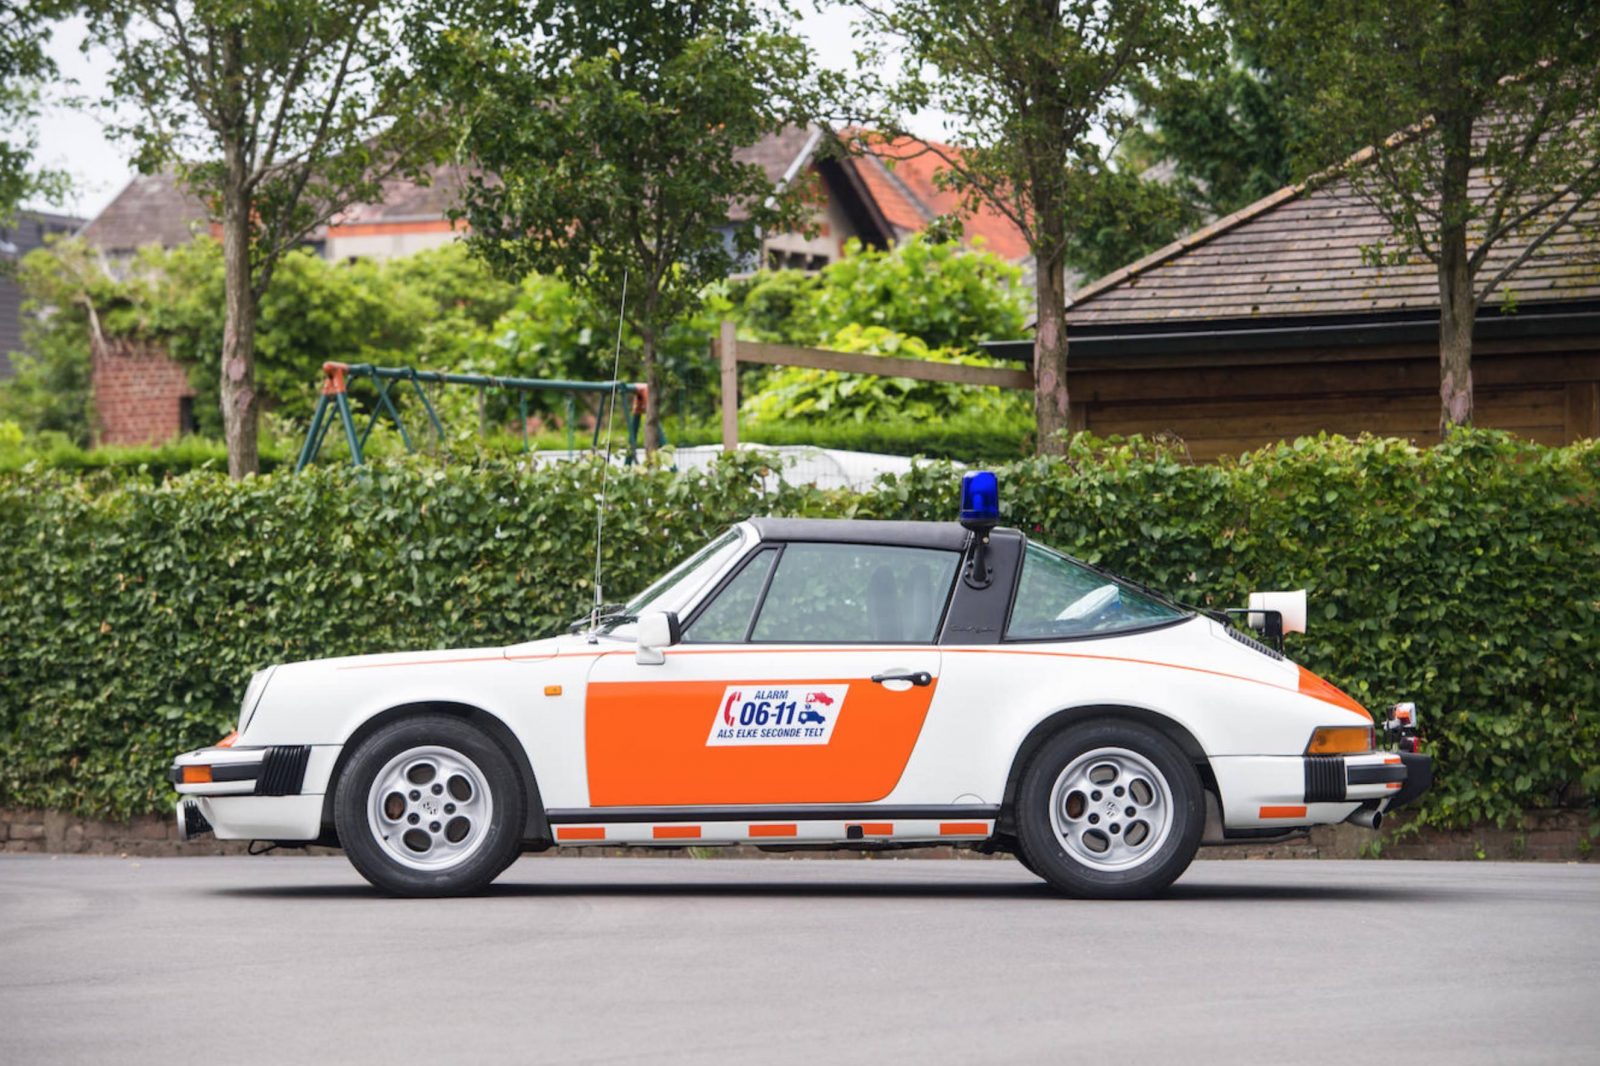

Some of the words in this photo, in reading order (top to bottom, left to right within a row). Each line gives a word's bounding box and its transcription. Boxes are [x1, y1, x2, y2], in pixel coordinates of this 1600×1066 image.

[754, 690, 789, 700] ALARM
[740, 701, 797, 726] 06-11
[717, 728, 734, 738] ALS
[736, 728, 758, 738] ELKE
[760, 728, 801, 738] SECONDE
[803, 727, 825, 737] TELT
